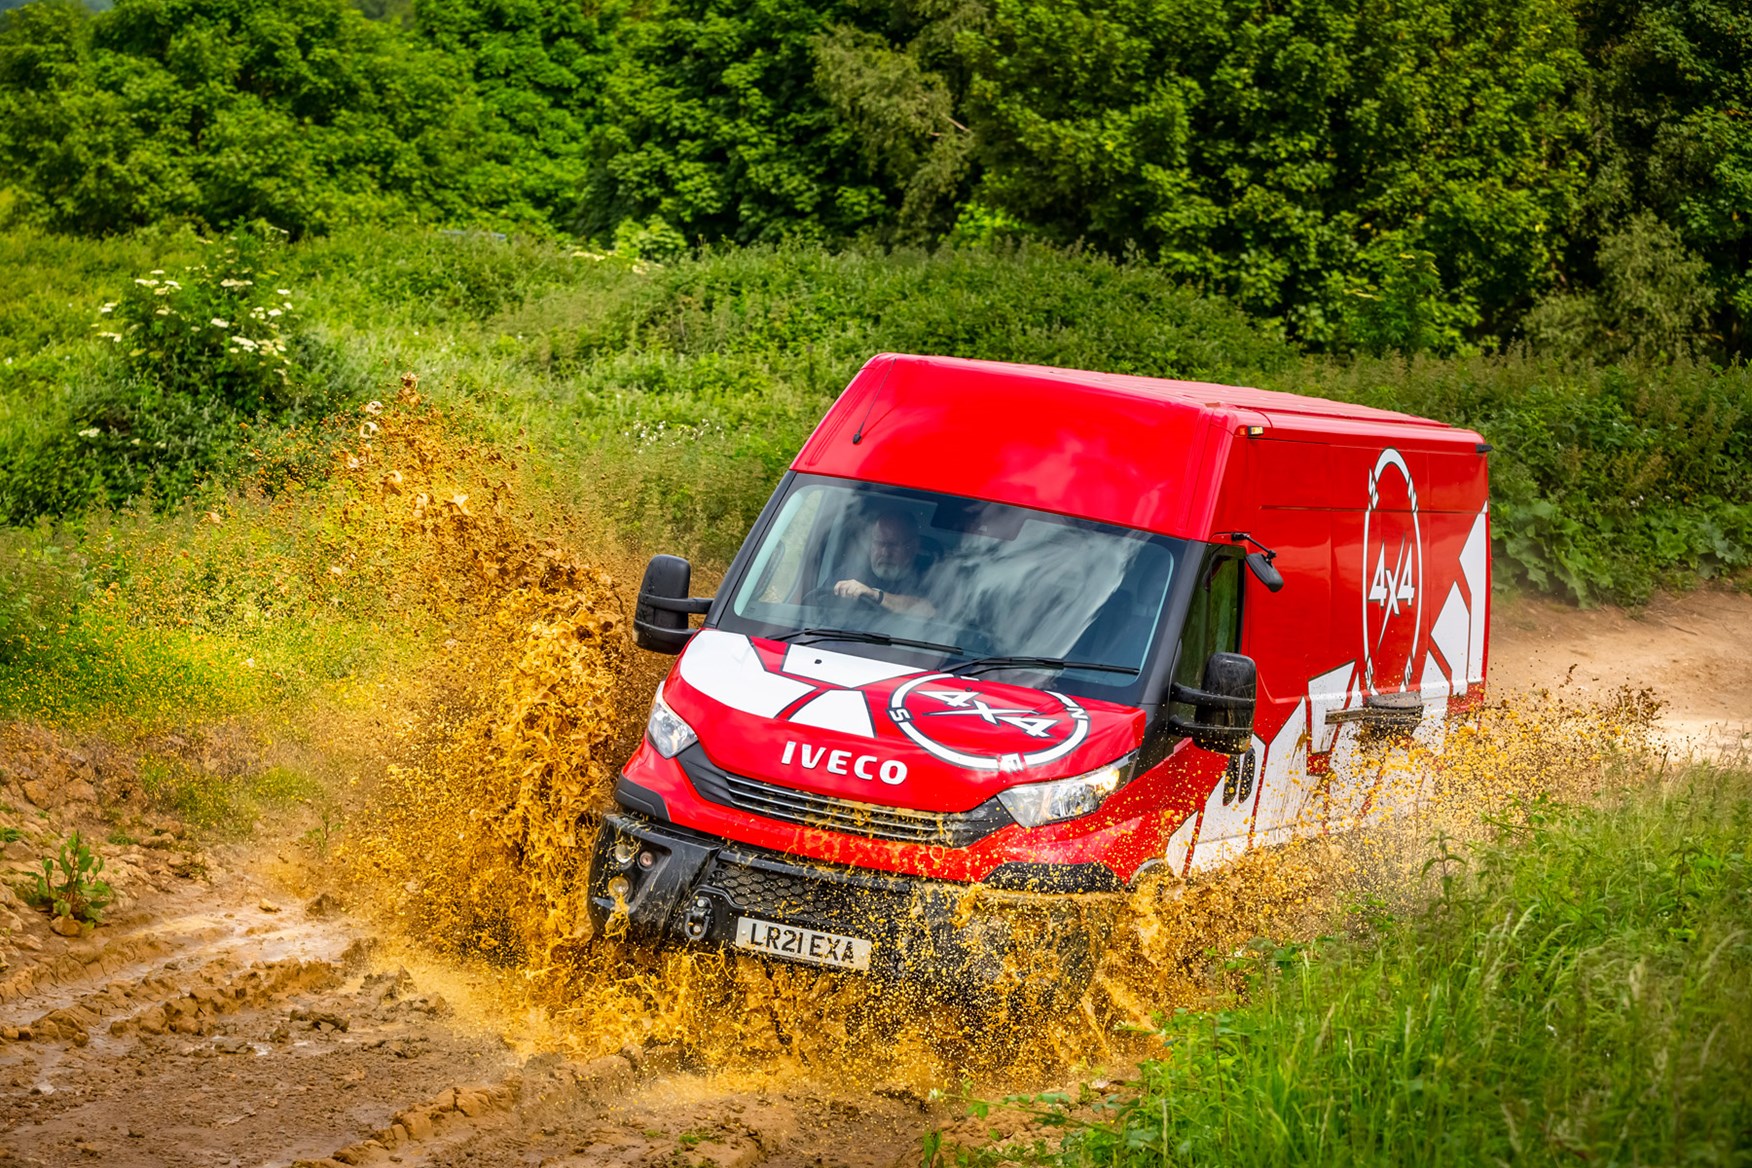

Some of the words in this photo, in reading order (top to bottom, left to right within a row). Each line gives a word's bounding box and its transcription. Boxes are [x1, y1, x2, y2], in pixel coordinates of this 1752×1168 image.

[780, 740, 908, 786] IVECO
[750, 922, 804, 954] LR21
[808, 933, 855, 964] EXA
